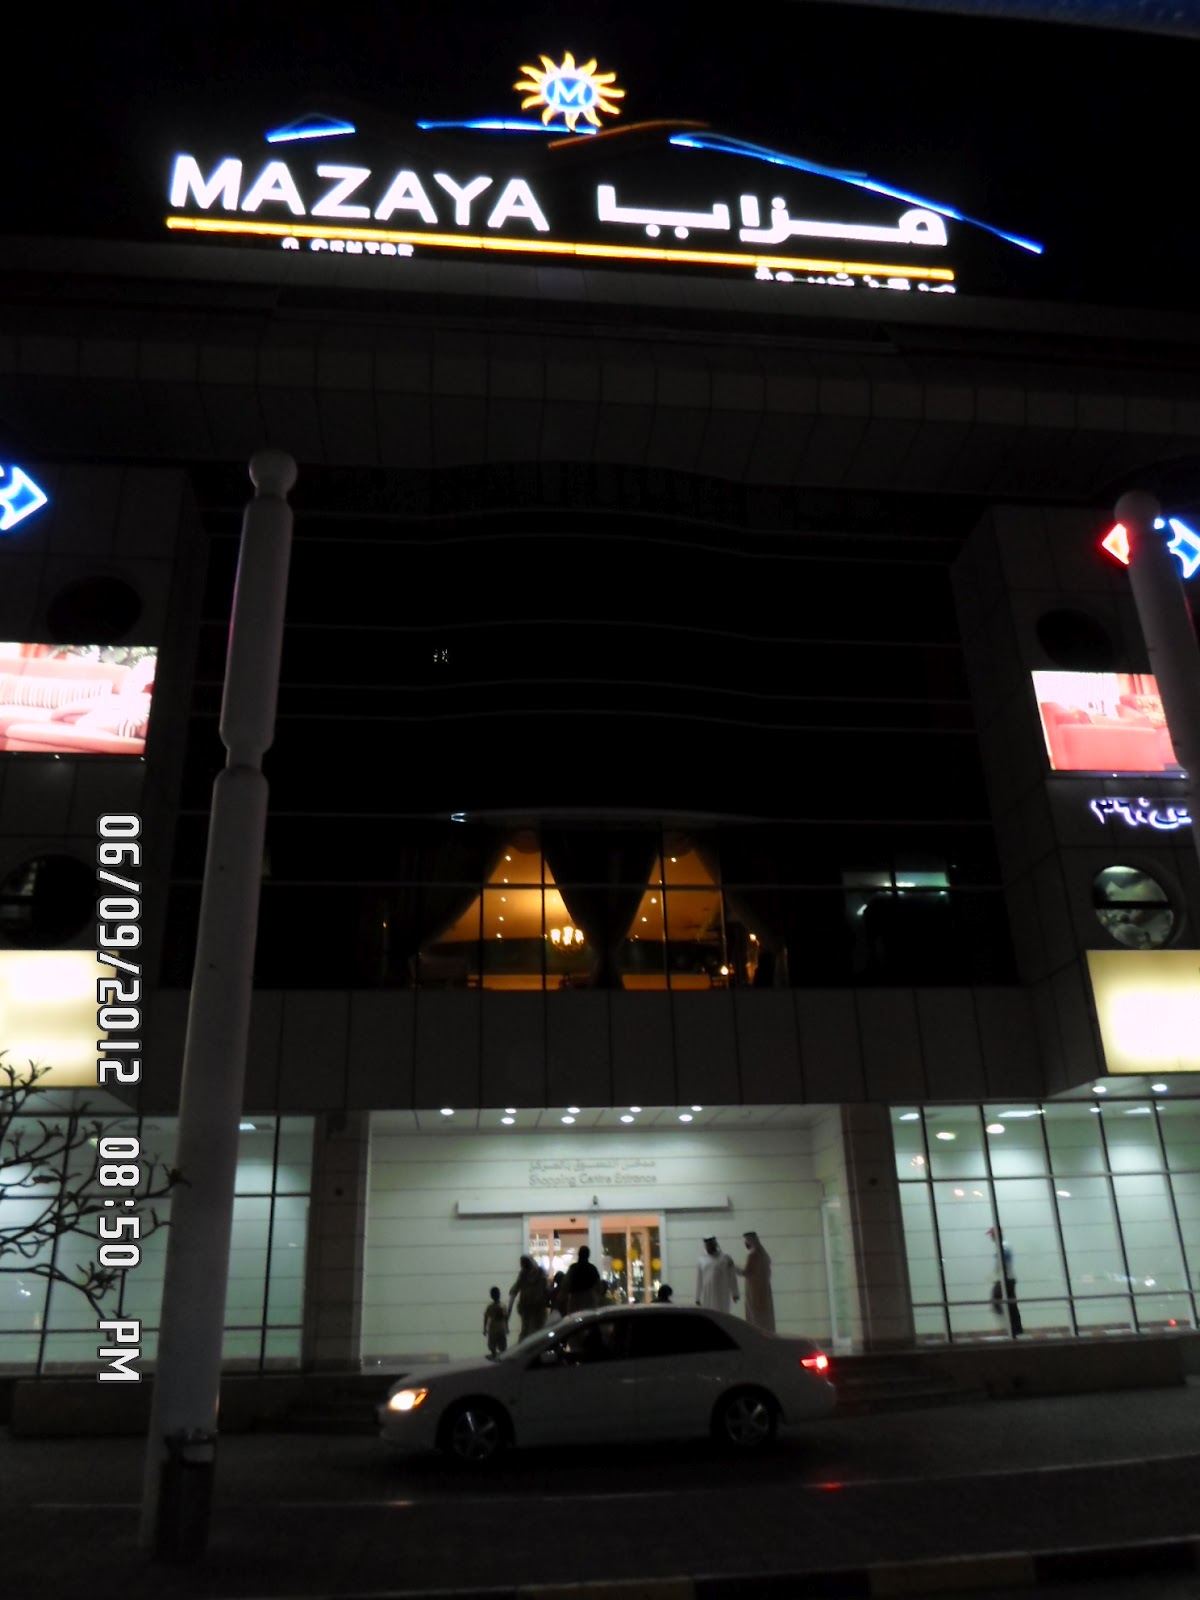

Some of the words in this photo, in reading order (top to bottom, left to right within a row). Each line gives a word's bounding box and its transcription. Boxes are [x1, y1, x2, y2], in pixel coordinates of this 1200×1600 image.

[552, 78, 587, 106] M
[168, 154, 550, 232] MAZAYA
[597, 184, 949, 246] مزايا
[528, 1173, 577, 1188] Shopping
[614, 1171, 657, 1184] Entrance
